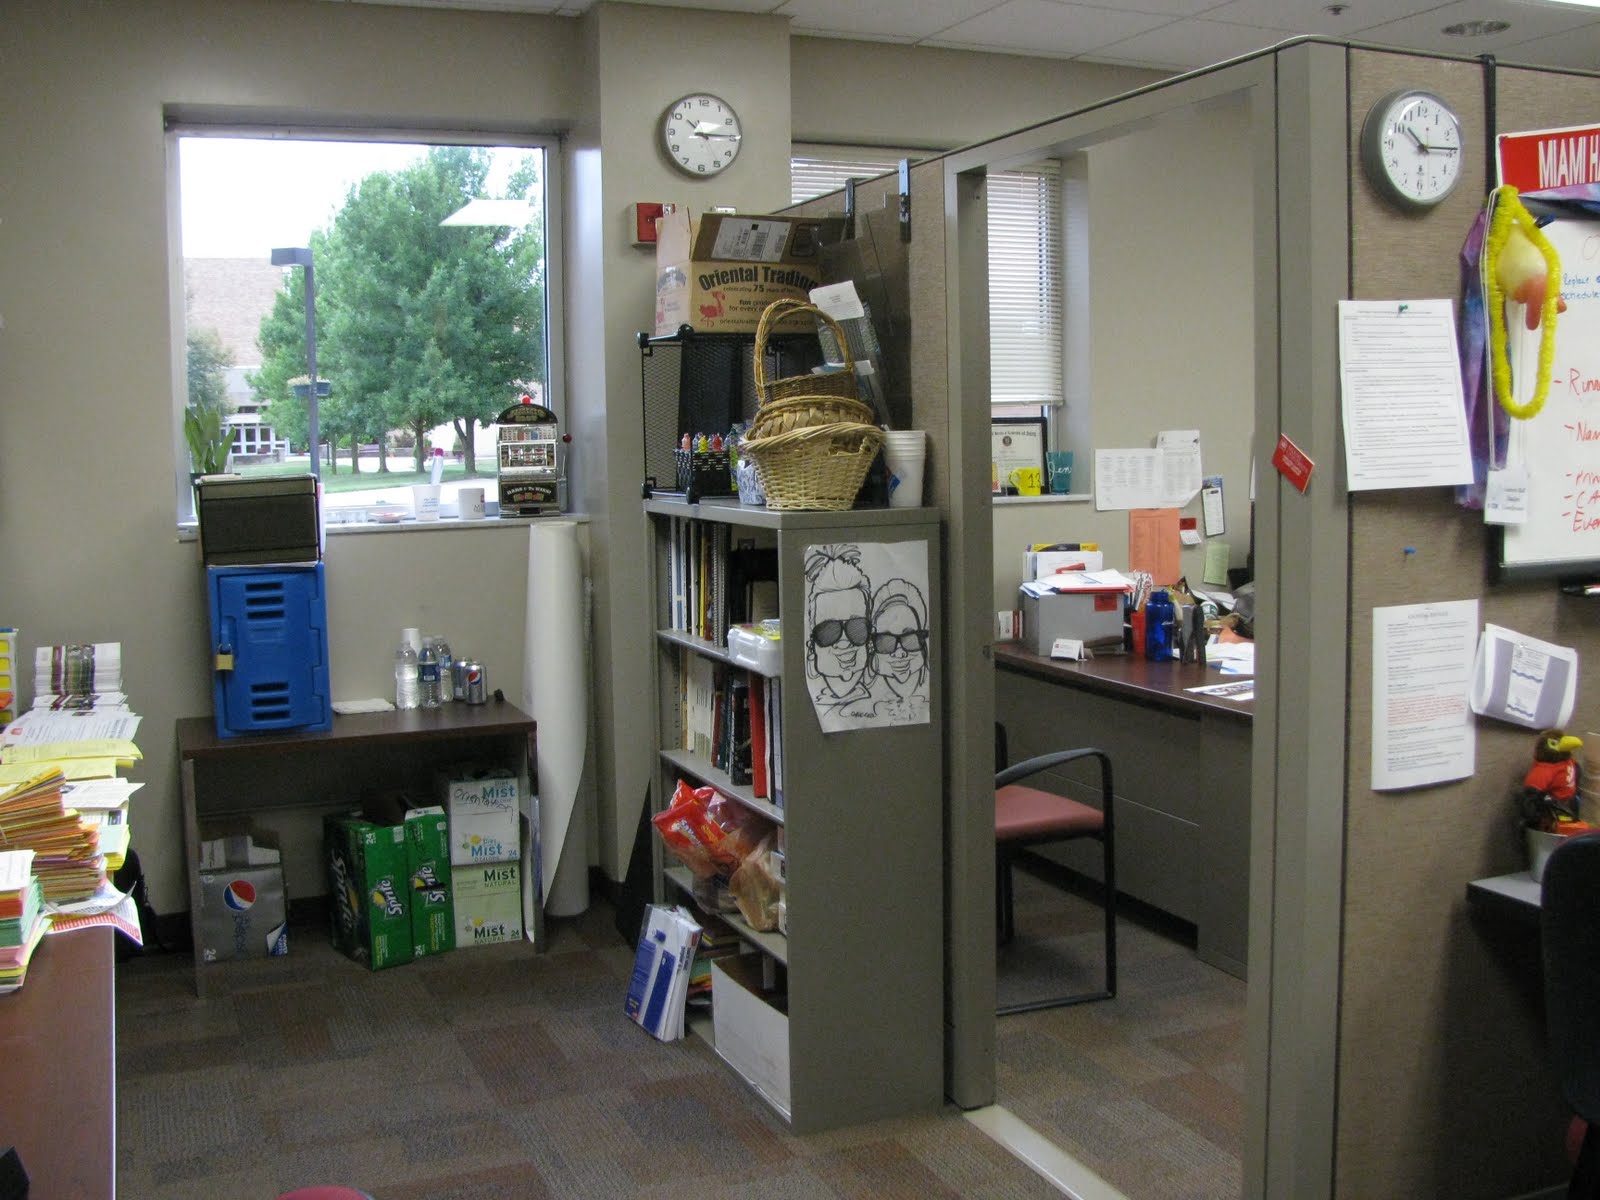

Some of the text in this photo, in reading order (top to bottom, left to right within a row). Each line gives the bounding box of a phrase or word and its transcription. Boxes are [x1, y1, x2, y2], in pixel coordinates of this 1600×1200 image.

[699, 99, 709, 107] 12
[1418, 106, 1428, 118] 12
[1394, 122, 1405, 134] 10
[1444, 130, 1450, 141] 2
[1589, 134, 1600, 182] H
[699, 265, 758, 291] Oriental
[753, 284, 765, 292] 75
[482, 784, 516, 800] Mist
[366, 832, 374, 845] 24
[471, 843, 503, 858] Mist
[508, 849, 517, 858] 24
[484, 867, 516, 882] Mist
[484, 879, 517, 888] NATURAL
[381, 879, 403, 915] Sprite
[474, 923, 505, 939] Mist
[415, 944, 423, 957] 24
